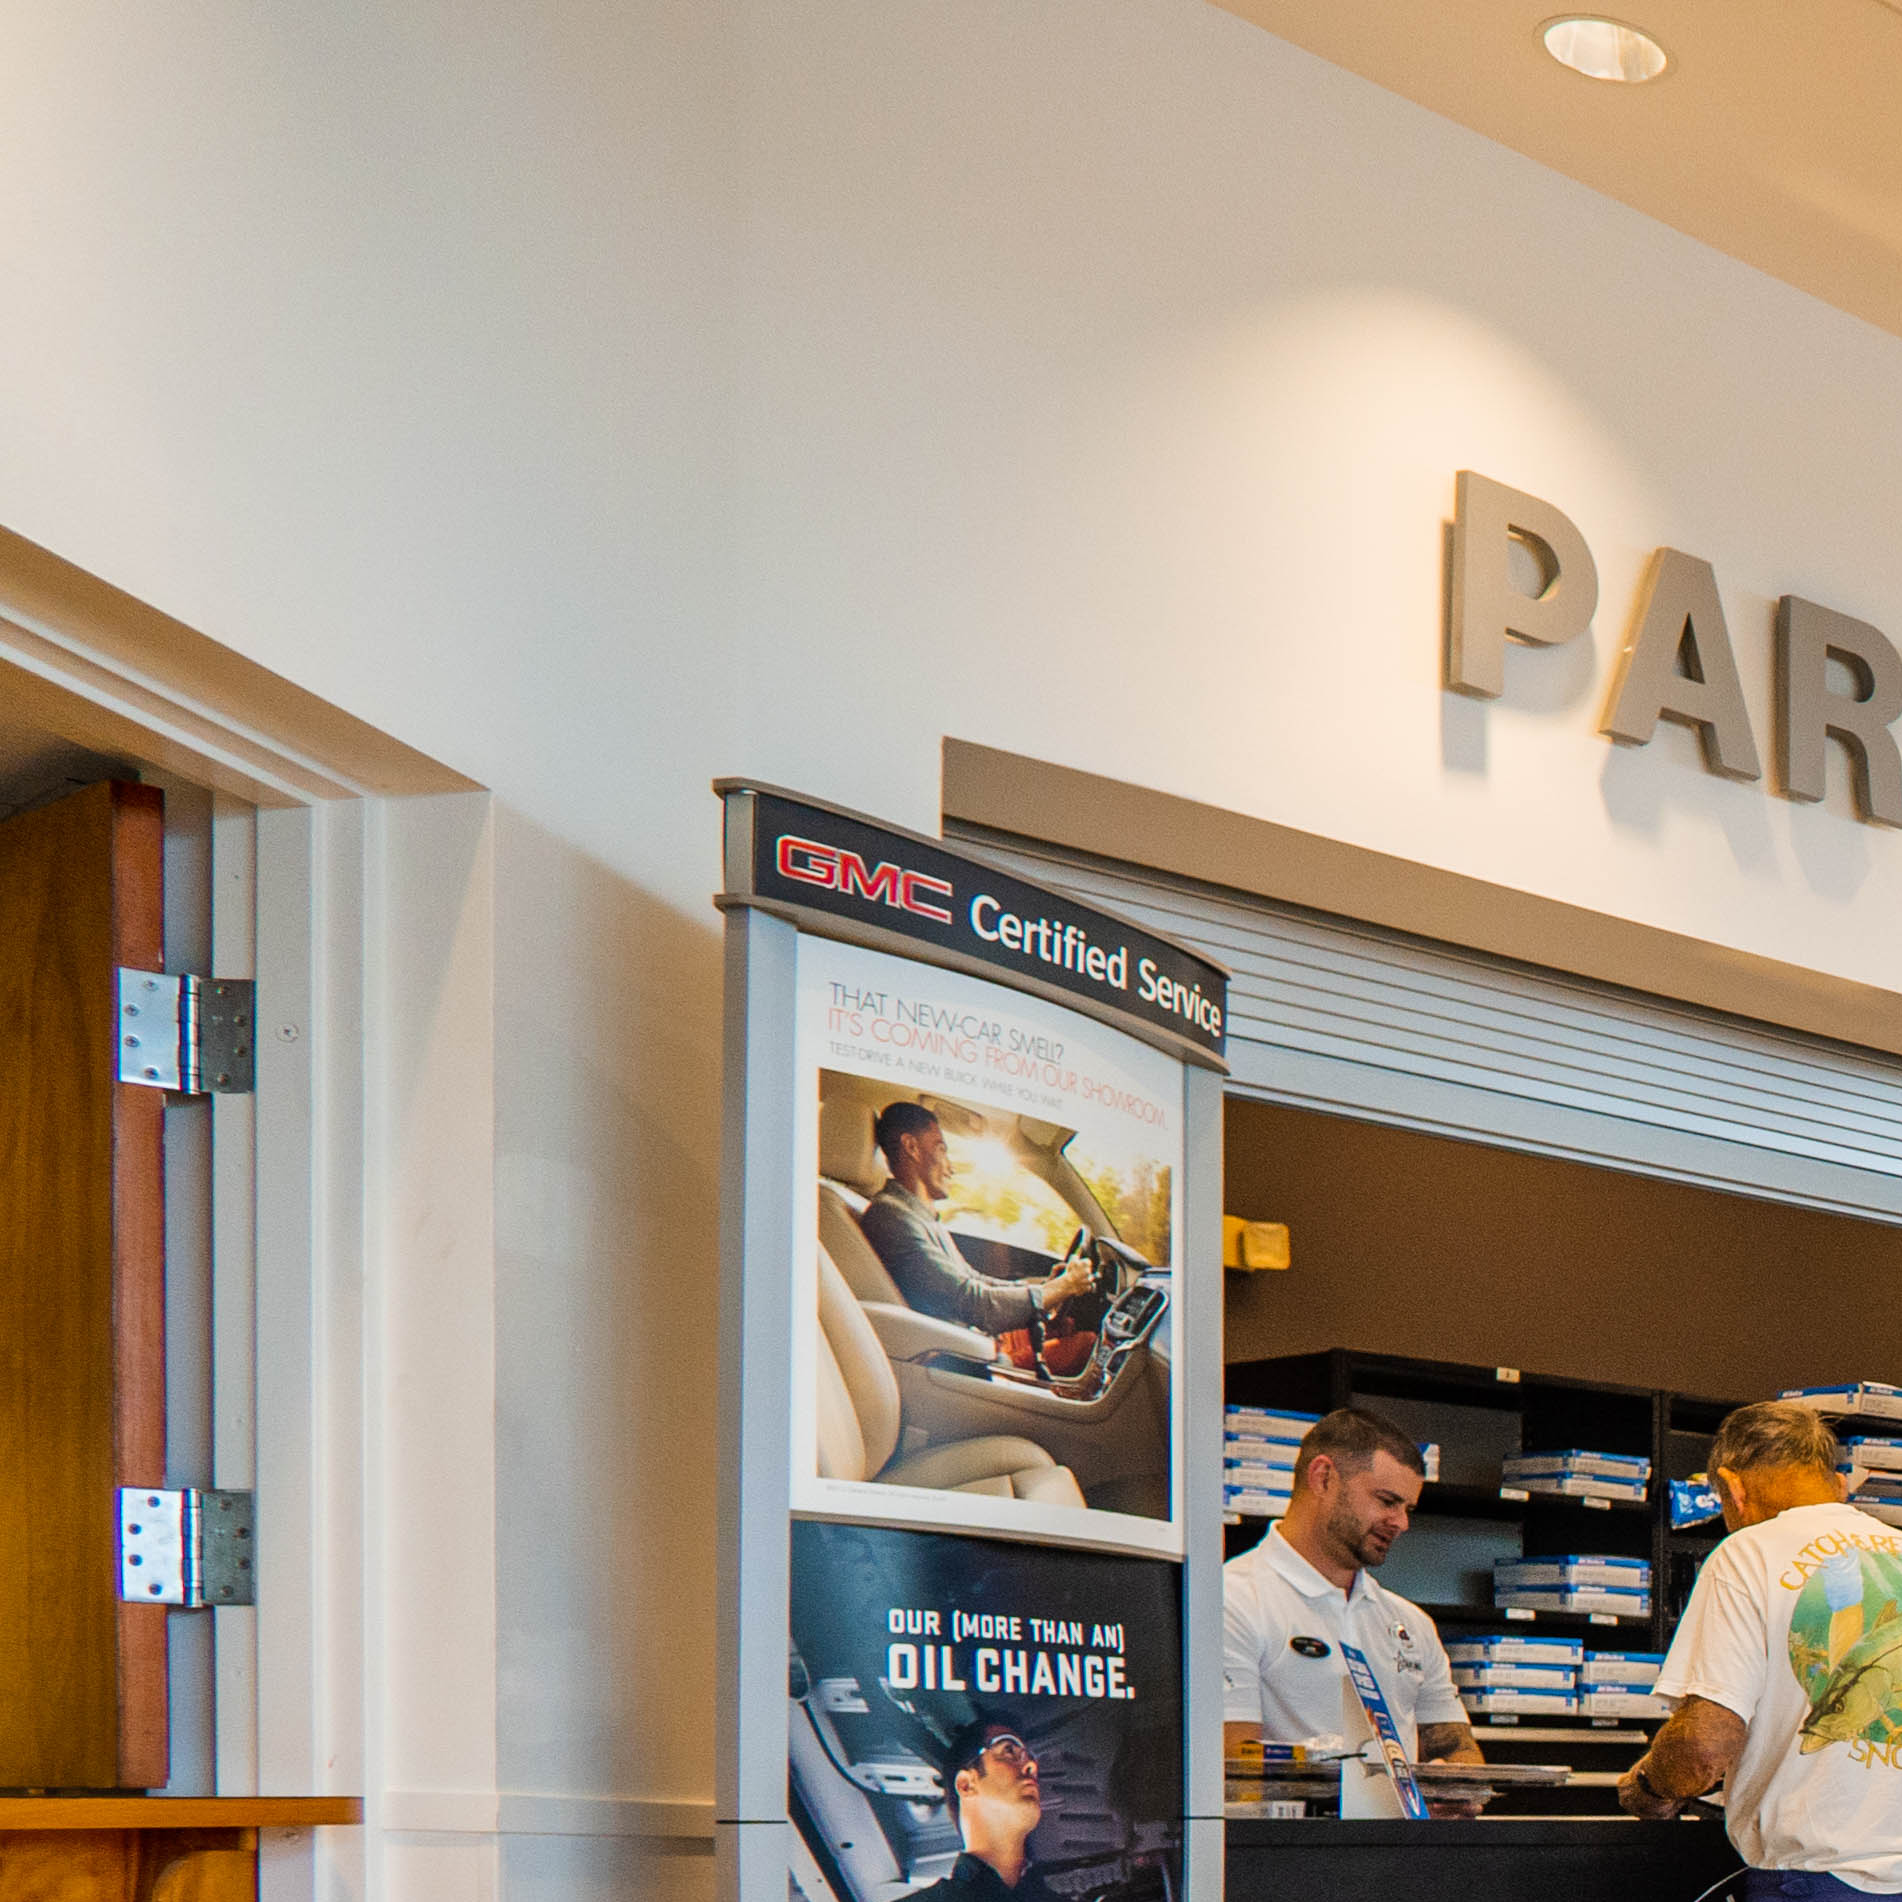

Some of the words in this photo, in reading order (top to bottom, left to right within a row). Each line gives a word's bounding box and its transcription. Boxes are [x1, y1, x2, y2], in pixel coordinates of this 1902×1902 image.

[777, 834, 953, 925] GMC
[970, 894, 1128, 990] Certified
[1137, 957, 1222, 1038] Service
[828, 1007, 864, 1038] IT'S
[871, 1018, 978, 1065] COMING
[984, 1047, 1039, 1083] FROM
[1041, 1061, 1078, 1093] OUR
[829, 982, 888, 1010] THAT
[896, 998, 1001, 1042] NEW-CAR
[1008, 1027, 1064, 1065] SMELL?
[894, 1055, 905, 1069] A
[908, 1058, 941, 1080] NEW
[943, 1066, 978, 1089] BUICK
[1779, 1529, 1852, 1591] CATCH
[888, 1608, 942, 1636] OUR
[952, 1609, 1022, 1643] (MORE
[1029, 1618, 1084, 1646] THAN
[1090, 1622, 1125, 1655] AN)
[887, 1643, 967, 1691] OIL
[976, 1647, 1135, 1699] CHANGE.
